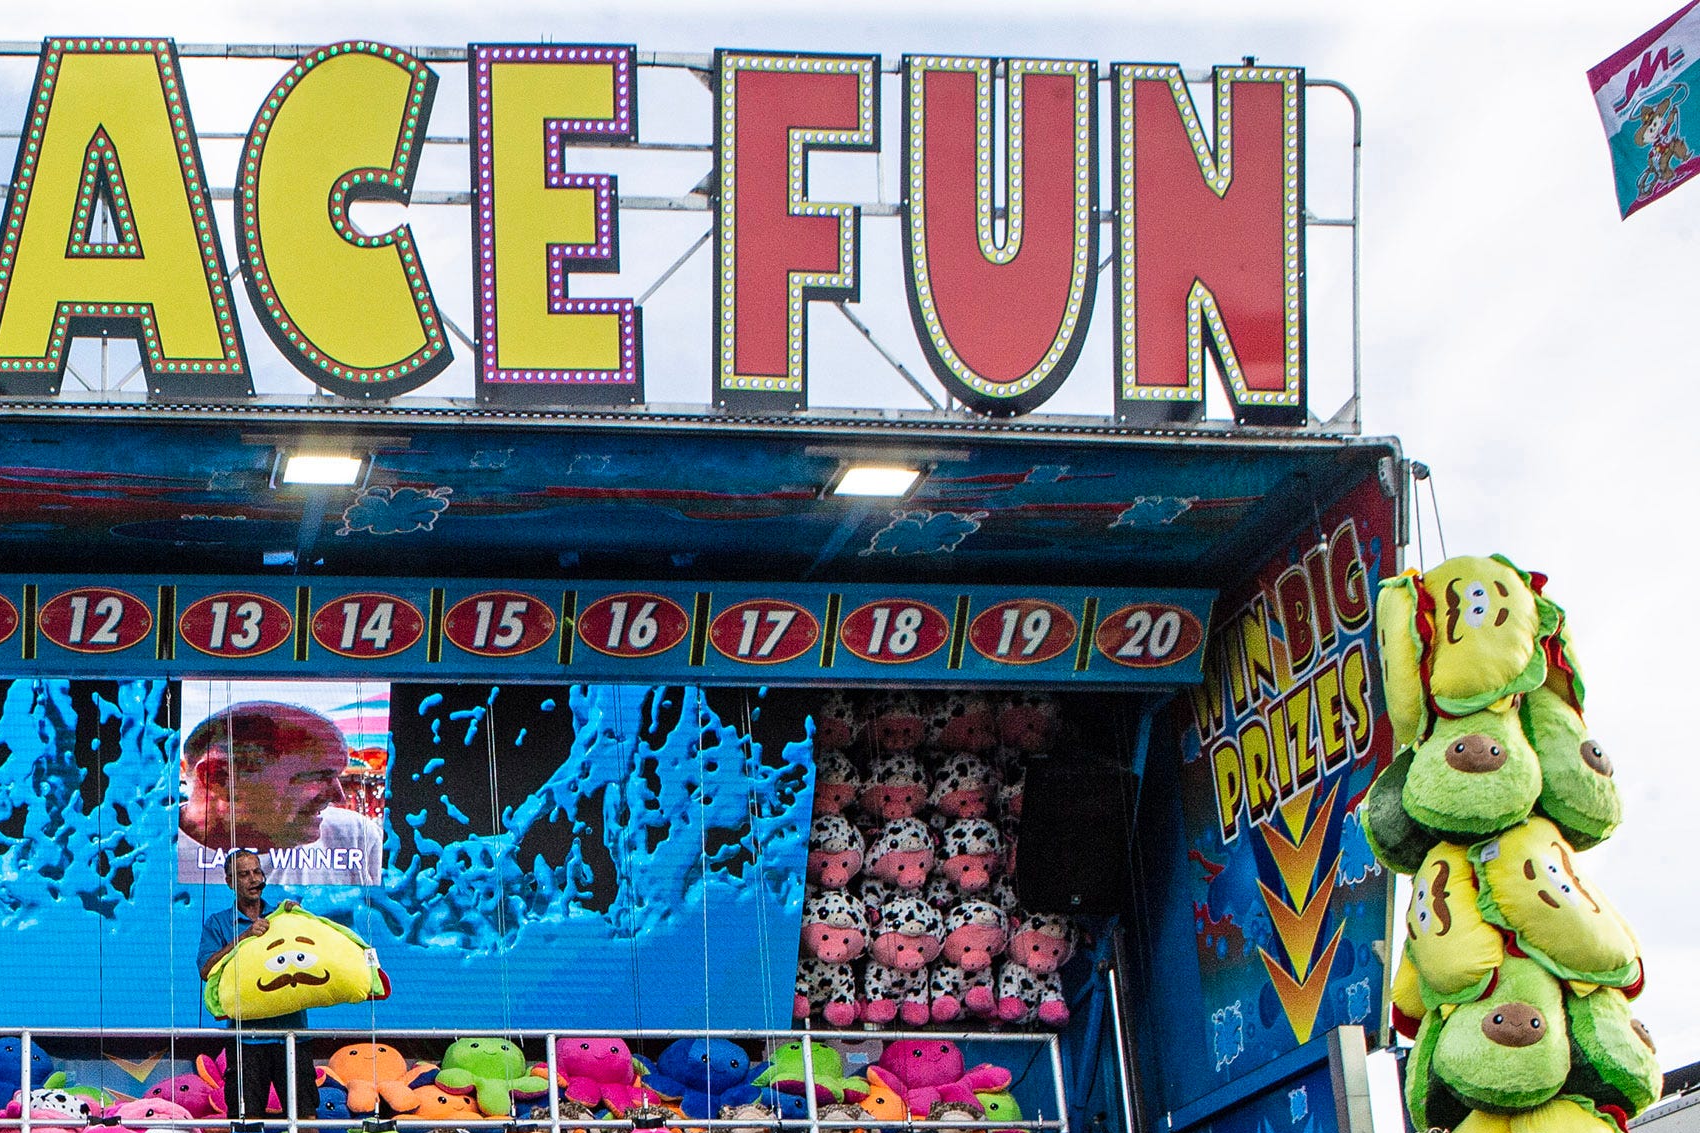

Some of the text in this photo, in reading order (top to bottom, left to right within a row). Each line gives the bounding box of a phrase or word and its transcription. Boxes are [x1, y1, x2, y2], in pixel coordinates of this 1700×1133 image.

[711, 48, 1308, 425] FUN
[68, 596, 123, 644] 12
[209, 601, 262, 649] 13
[339, 602, 393, 649] 14
[472, 601, 527, 648] 15
[606, 602, 658, 649] 16
[736, 610, 796, 657] 17
[866, 608, 922, 655] 18
[995, 609, 1051, 657] 19
[1115, 610, 1180, 658] 20
[1191, 519, 1371, 745] WIN BIG
[1211, 640, 1372, 844] PRIZES
[270, 847, 363, 870] WINNER
